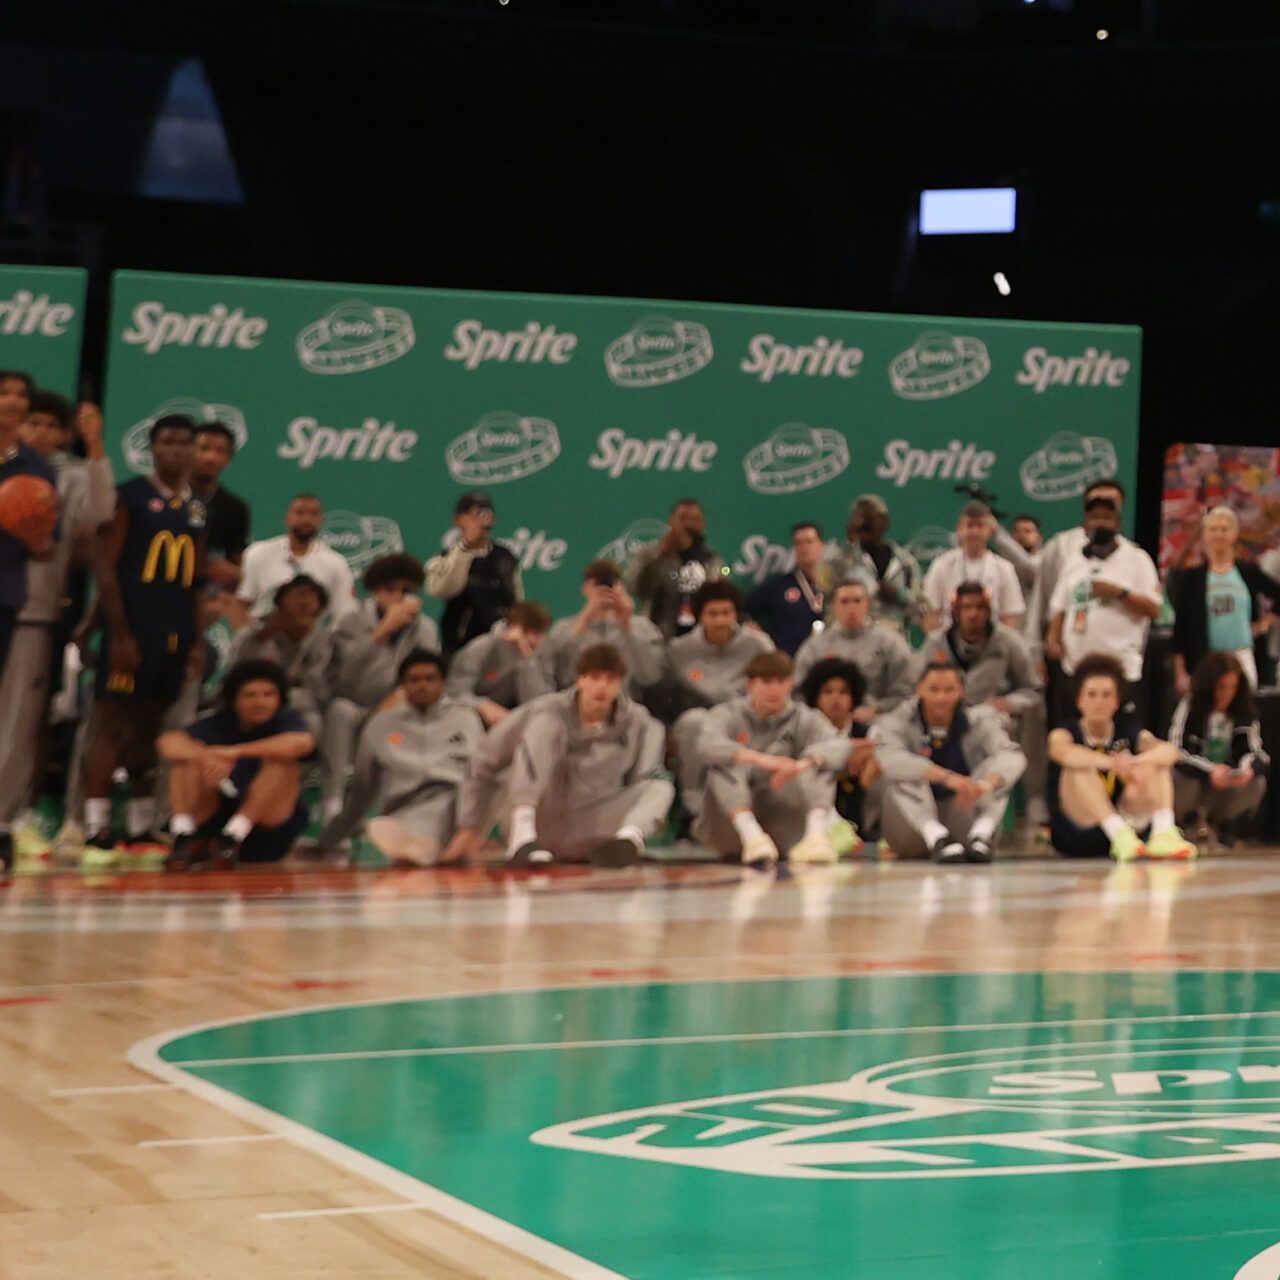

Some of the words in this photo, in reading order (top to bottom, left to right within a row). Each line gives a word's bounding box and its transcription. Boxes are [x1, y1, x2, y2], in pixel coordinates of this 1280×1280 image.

[122, 300, 268, 354] Sprite
[444, 320, 579, 370] Sprite
[740, 332, 865, 383] Sprite
[1015, 346, 1131, 395] Sprite
[277, 416, 418, 468] Sprite
[589, 427, 718, 479] Sprite
[876, 439, 997, 488] Sprite
